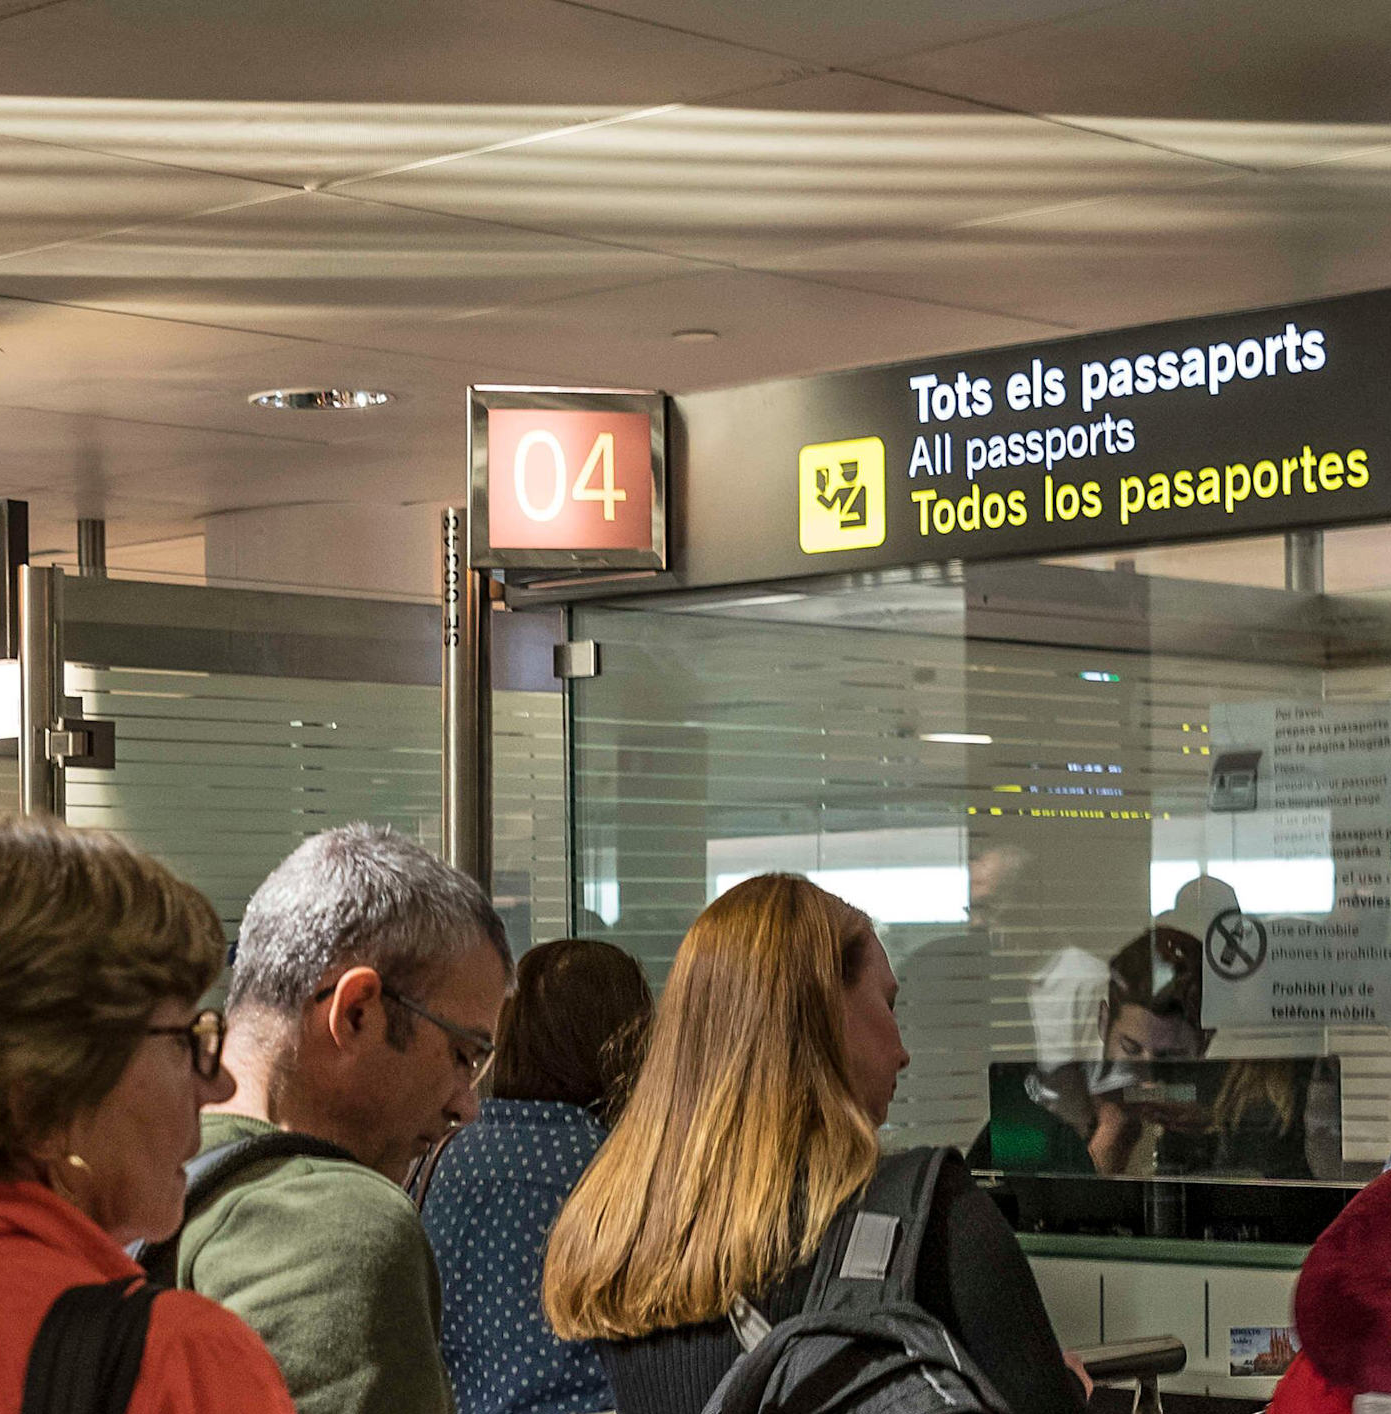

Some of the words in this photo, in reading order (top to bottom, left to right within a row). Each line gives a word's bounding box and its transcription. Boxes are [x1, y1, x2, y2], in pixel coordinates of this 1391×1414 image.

[909, 371, 993, 423] Tots
[1006, 358, 1066, 411] els
[1081, 323, 1326, 412] passaports
[513, 429, 627, 522] 04
[908, 432, 952, 478] All
[966, 412, 1136, 480] passports
[911, 483, 1028, 535] Todos
[1044, 474, 1103, 522] los
[1120, 445, 1370, 525] pasaportes
